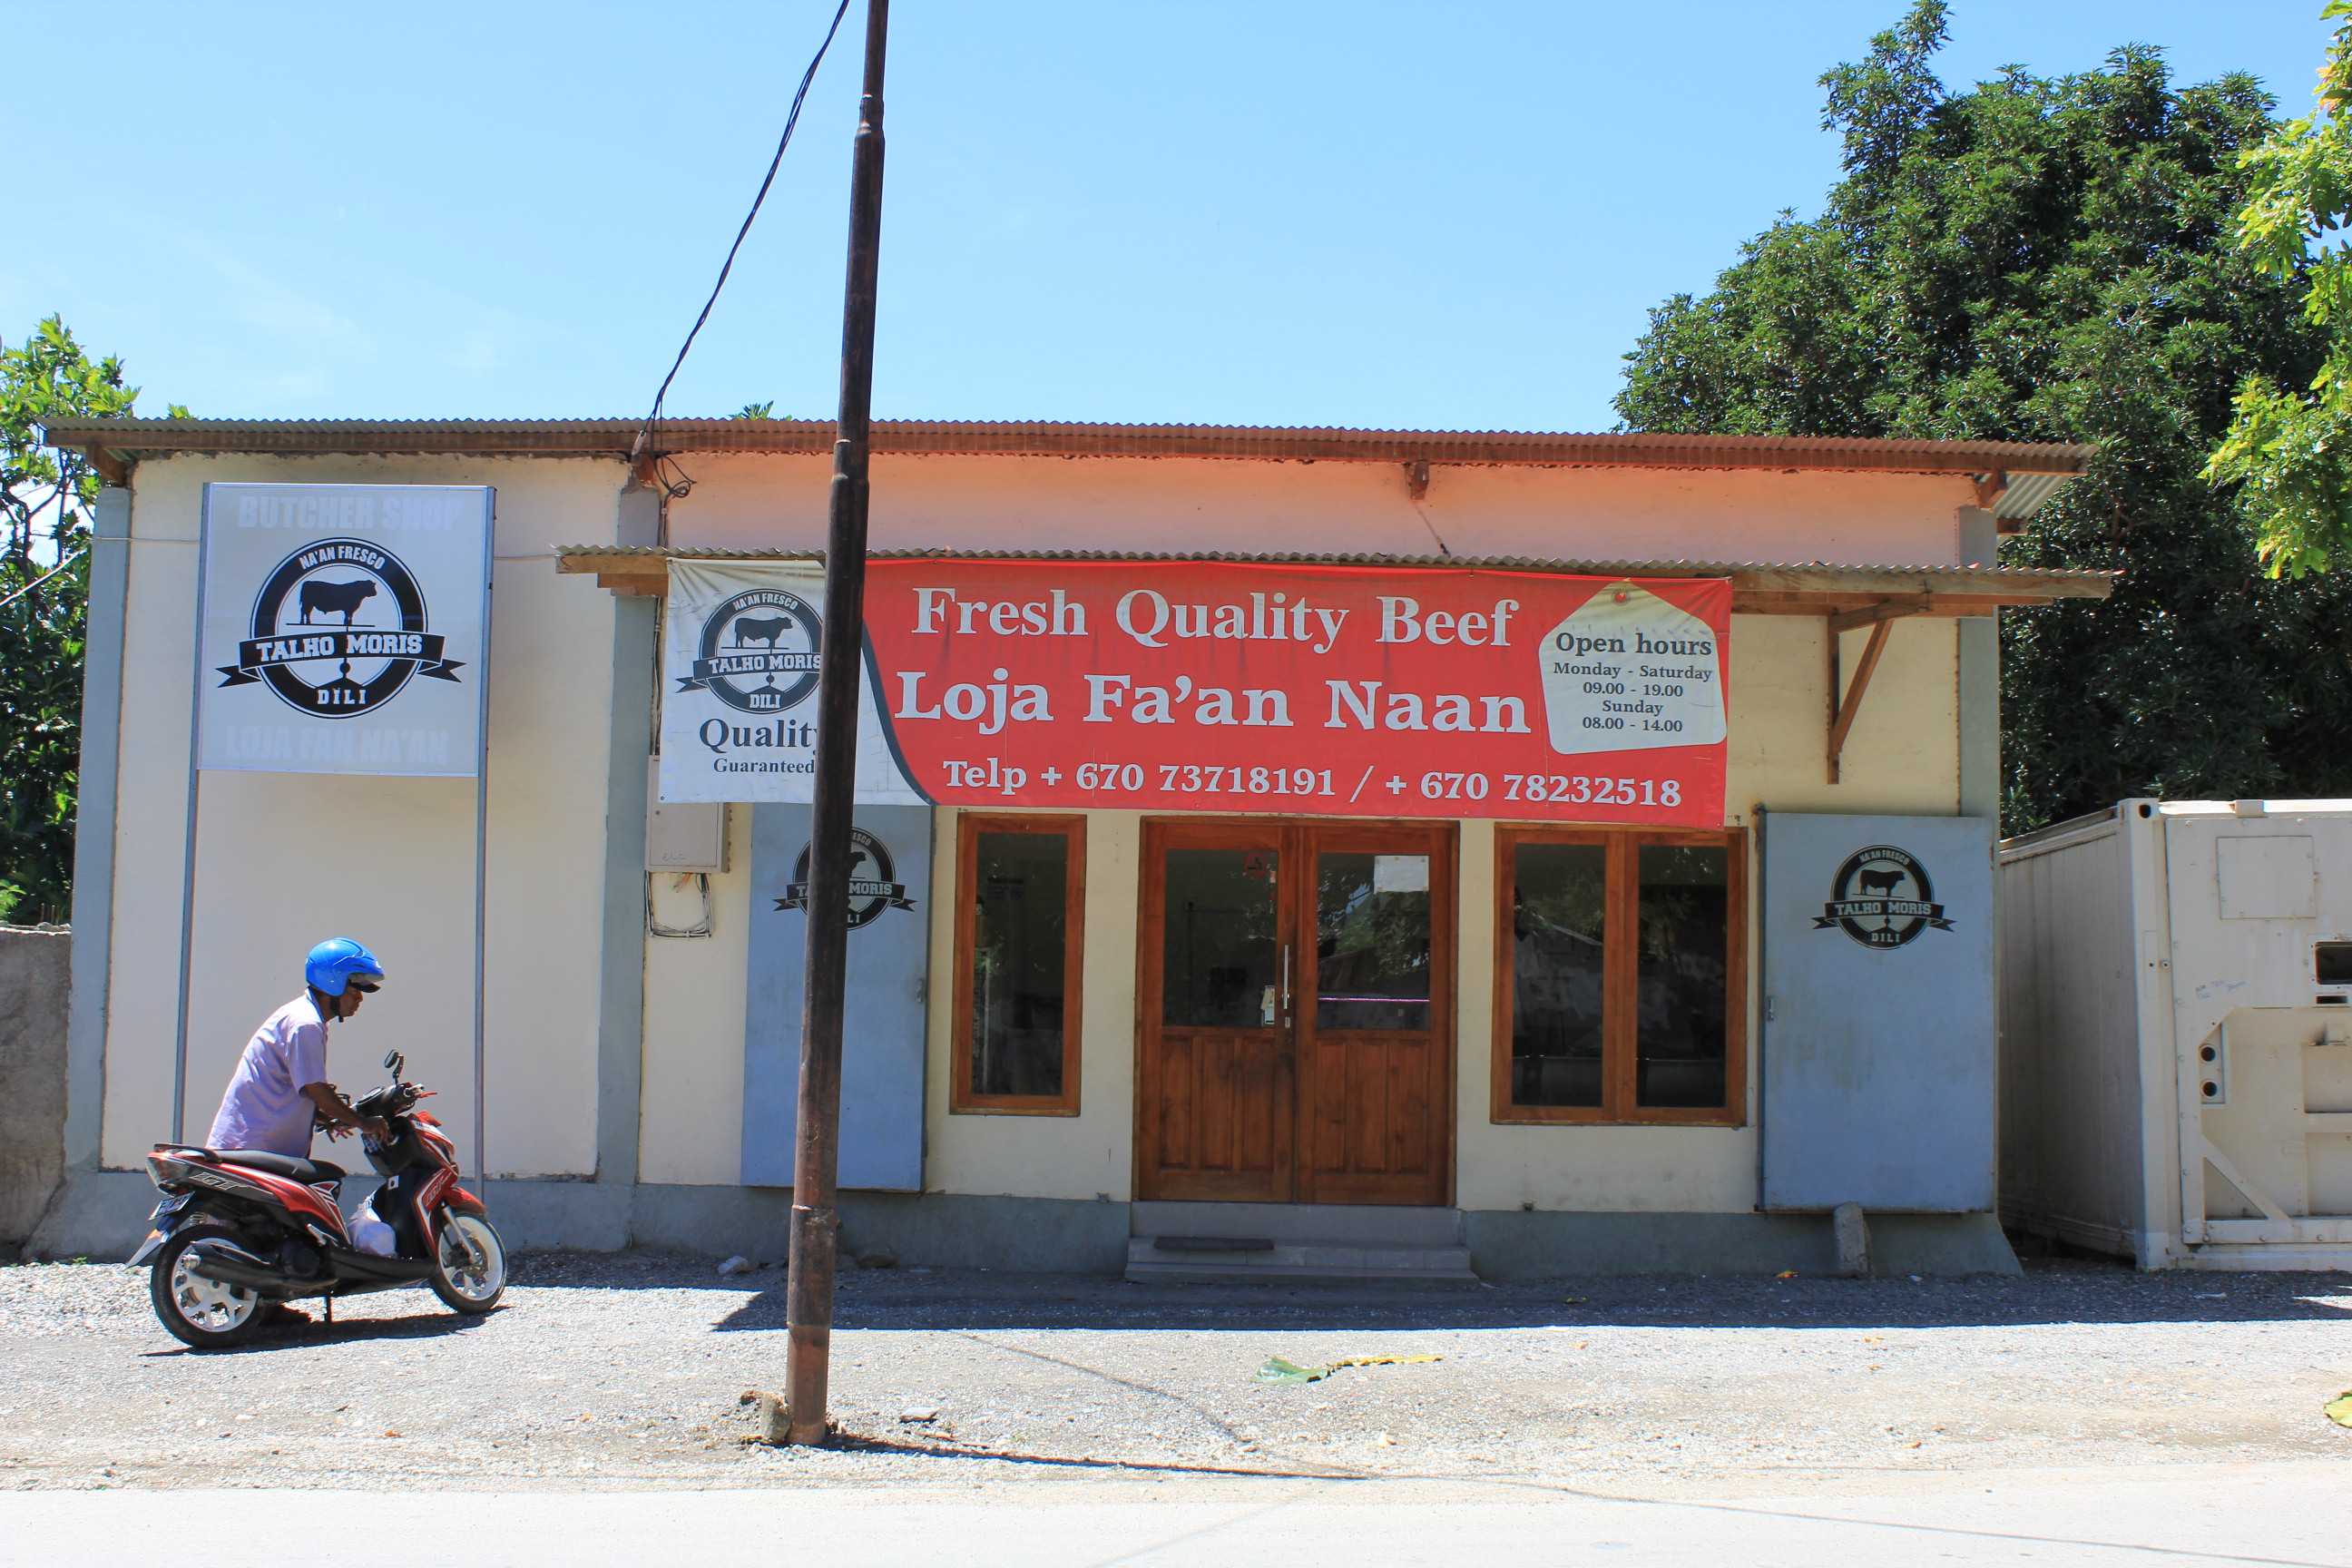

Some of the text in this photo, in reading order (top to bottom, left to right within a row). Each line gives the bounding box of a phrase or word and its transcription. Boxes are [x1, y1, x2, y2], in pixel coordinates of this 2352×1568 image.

[299, 545, 386, 570] NA'AN FRESCO
[762, 593, 799, 610] FRESCO
[912, 587, 1519, 654] Fresh Quality Beef
[256, 634, 422, 662] TALHO MORIS
[1555, 632, 1712, 656] Open hours
[709, 652, 820, 674] TALHO MORIS
[1553, 662, 1621, 677] Monday
[1640, 665, 1712, 681] Saturday
[317, 686, 367, 705] DILI
[1583, 682, 1624, 694] 09.00
[1643, 684, 1683, 697] 19.00
[750, 692, 782, 709] DILI
[894, 667, 1532, 735] Loja Fa'an Naan
[1602, 700, 1663, 716] Sunday
[1583, 717, 1624, 730] 08.00
[1642, 719, 1683, 731] 14.00
[700, 719, 818, 755] Qualit
[713, 758, 815, 774] Guaranteed
[943, 758, 1681, 807] Telp + 670 73718191 / + 670 78232518
[848, 883, 892, 895] MORIS
[1835, 903, 1931, 915] TALHO MORIS
[1872, 933, 1900, 943] DILI
